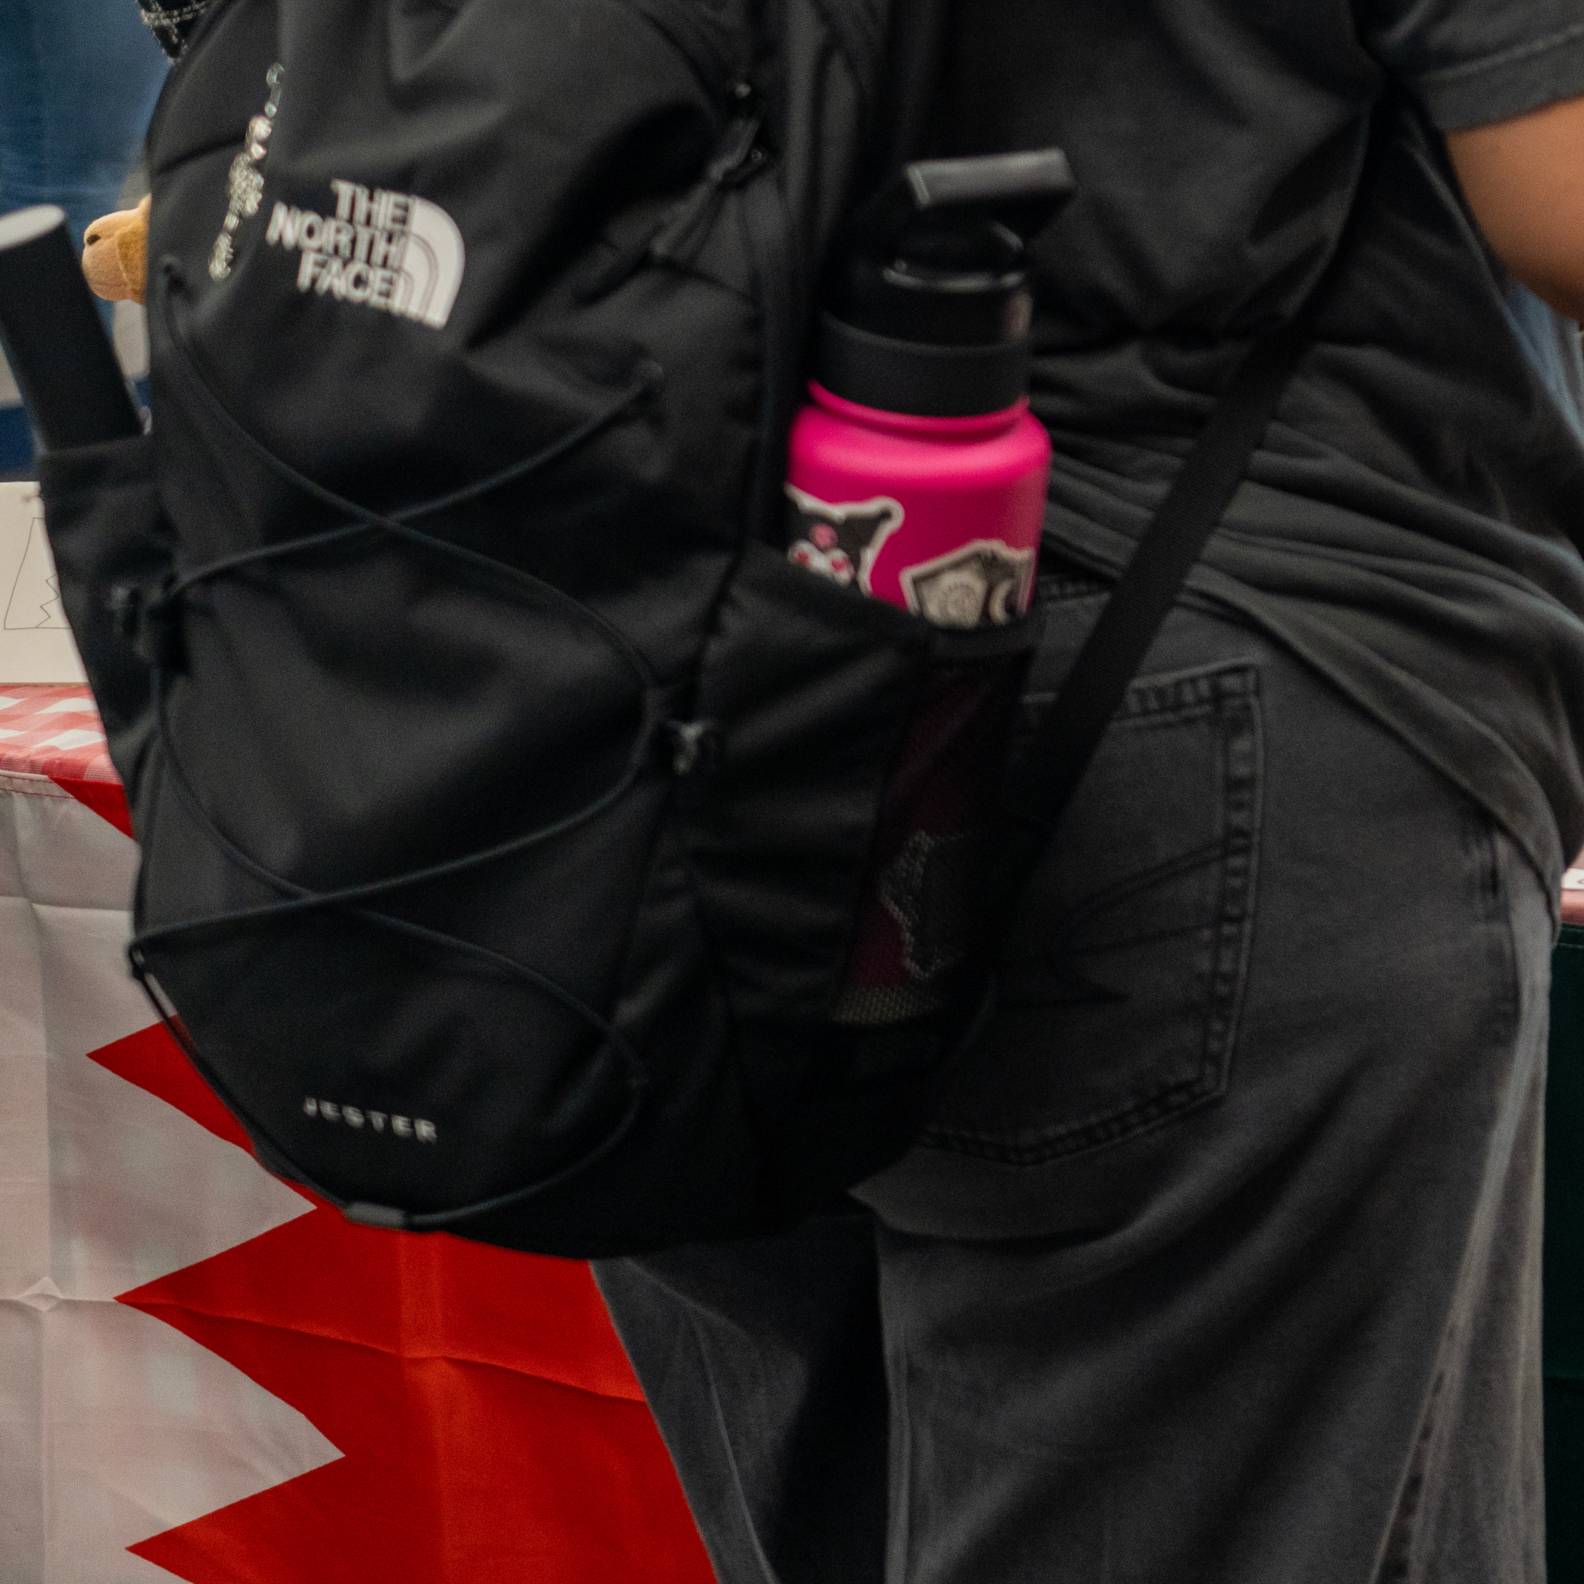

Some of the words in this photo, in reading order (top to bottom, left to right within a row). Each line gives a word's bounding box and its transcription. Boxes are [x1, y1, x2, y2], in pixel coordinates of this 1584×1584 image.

[331, 178, 411, 225] THE
[265, 201, 406, 271] NORTH
[296, 250, 397, 310] FACE
[303, 1094, 437, 1144] JESTER
